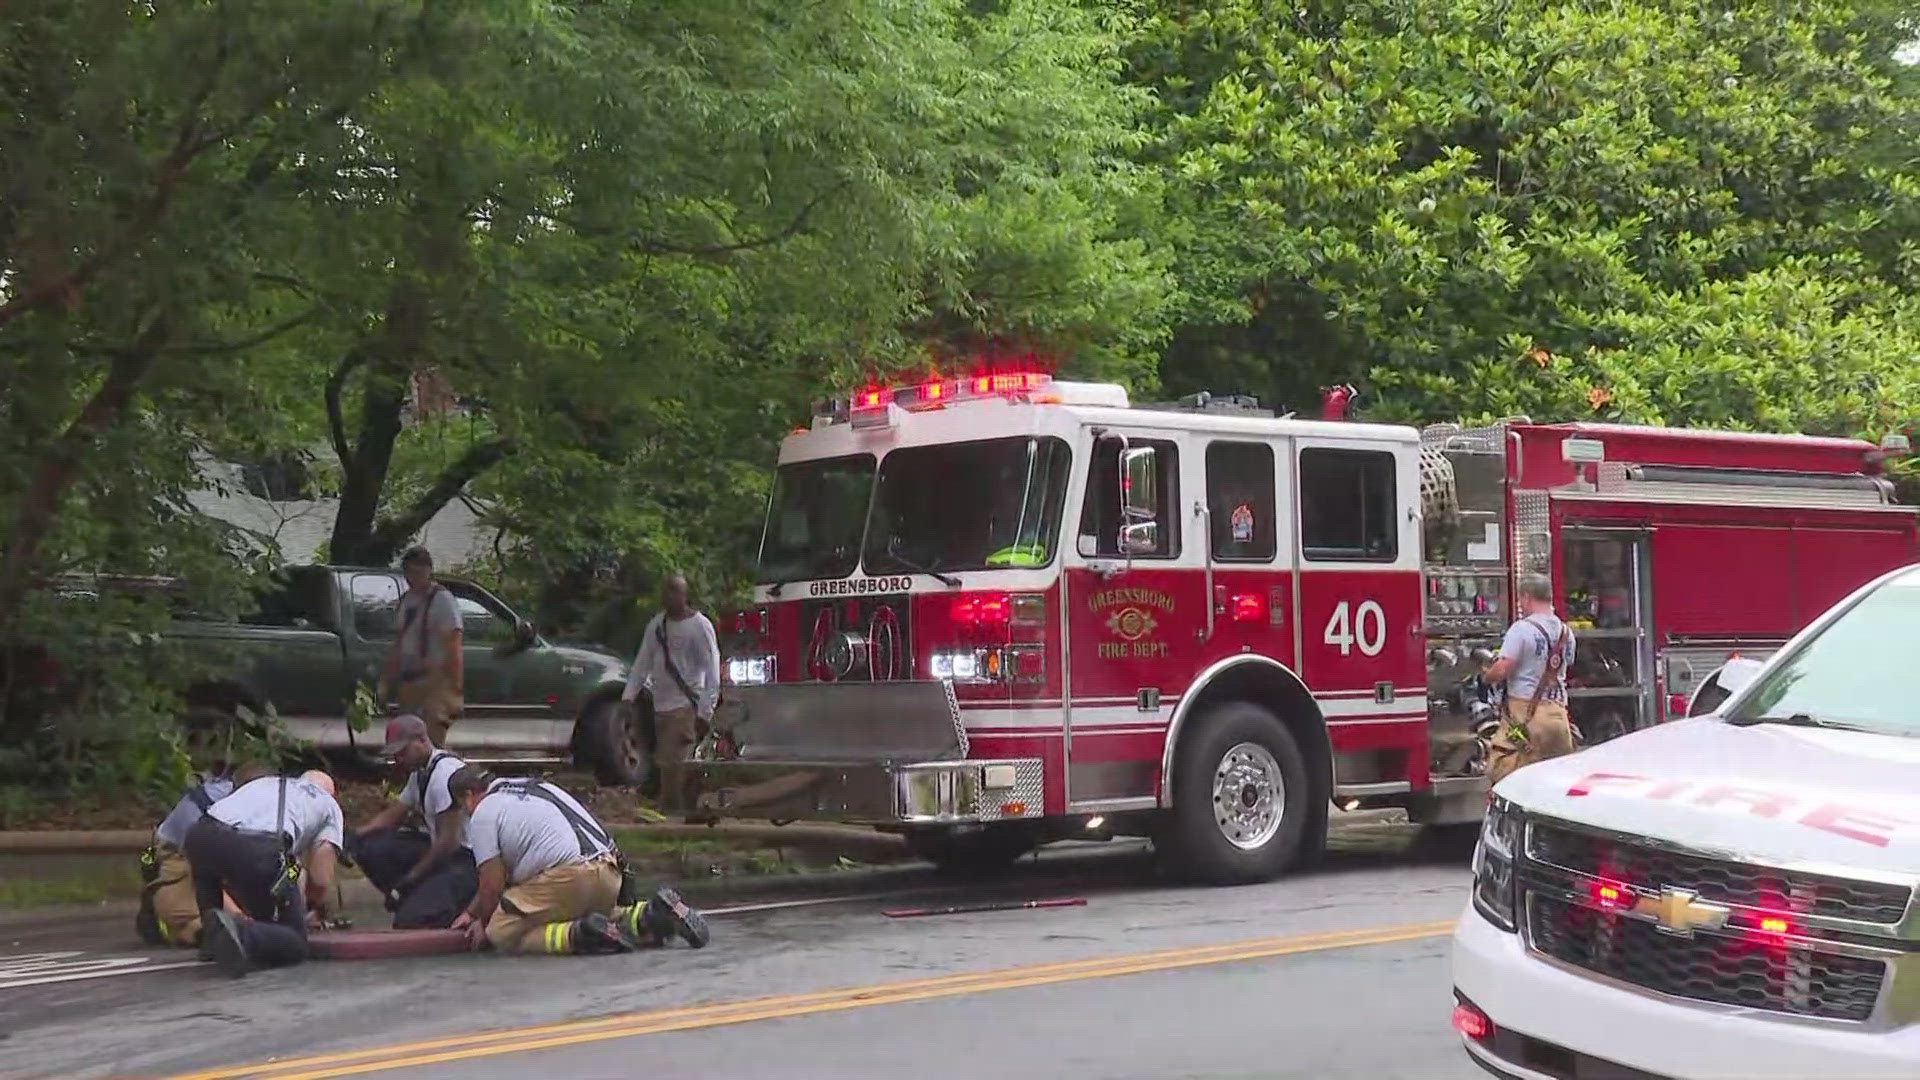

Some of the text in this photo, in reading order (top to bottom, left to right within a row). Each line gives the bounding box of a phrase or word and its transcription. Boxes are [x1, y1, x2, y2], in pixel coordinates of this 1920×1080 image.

[810, 576, 912, 596] GREENSBORO
[1088, 588, 1175, 613] GREENSBORO
[1324, 599, 1387, 657] 40
[1098, 642, 1128, 658] FIRE
[1566, 773, 1910, 848] FIRE
